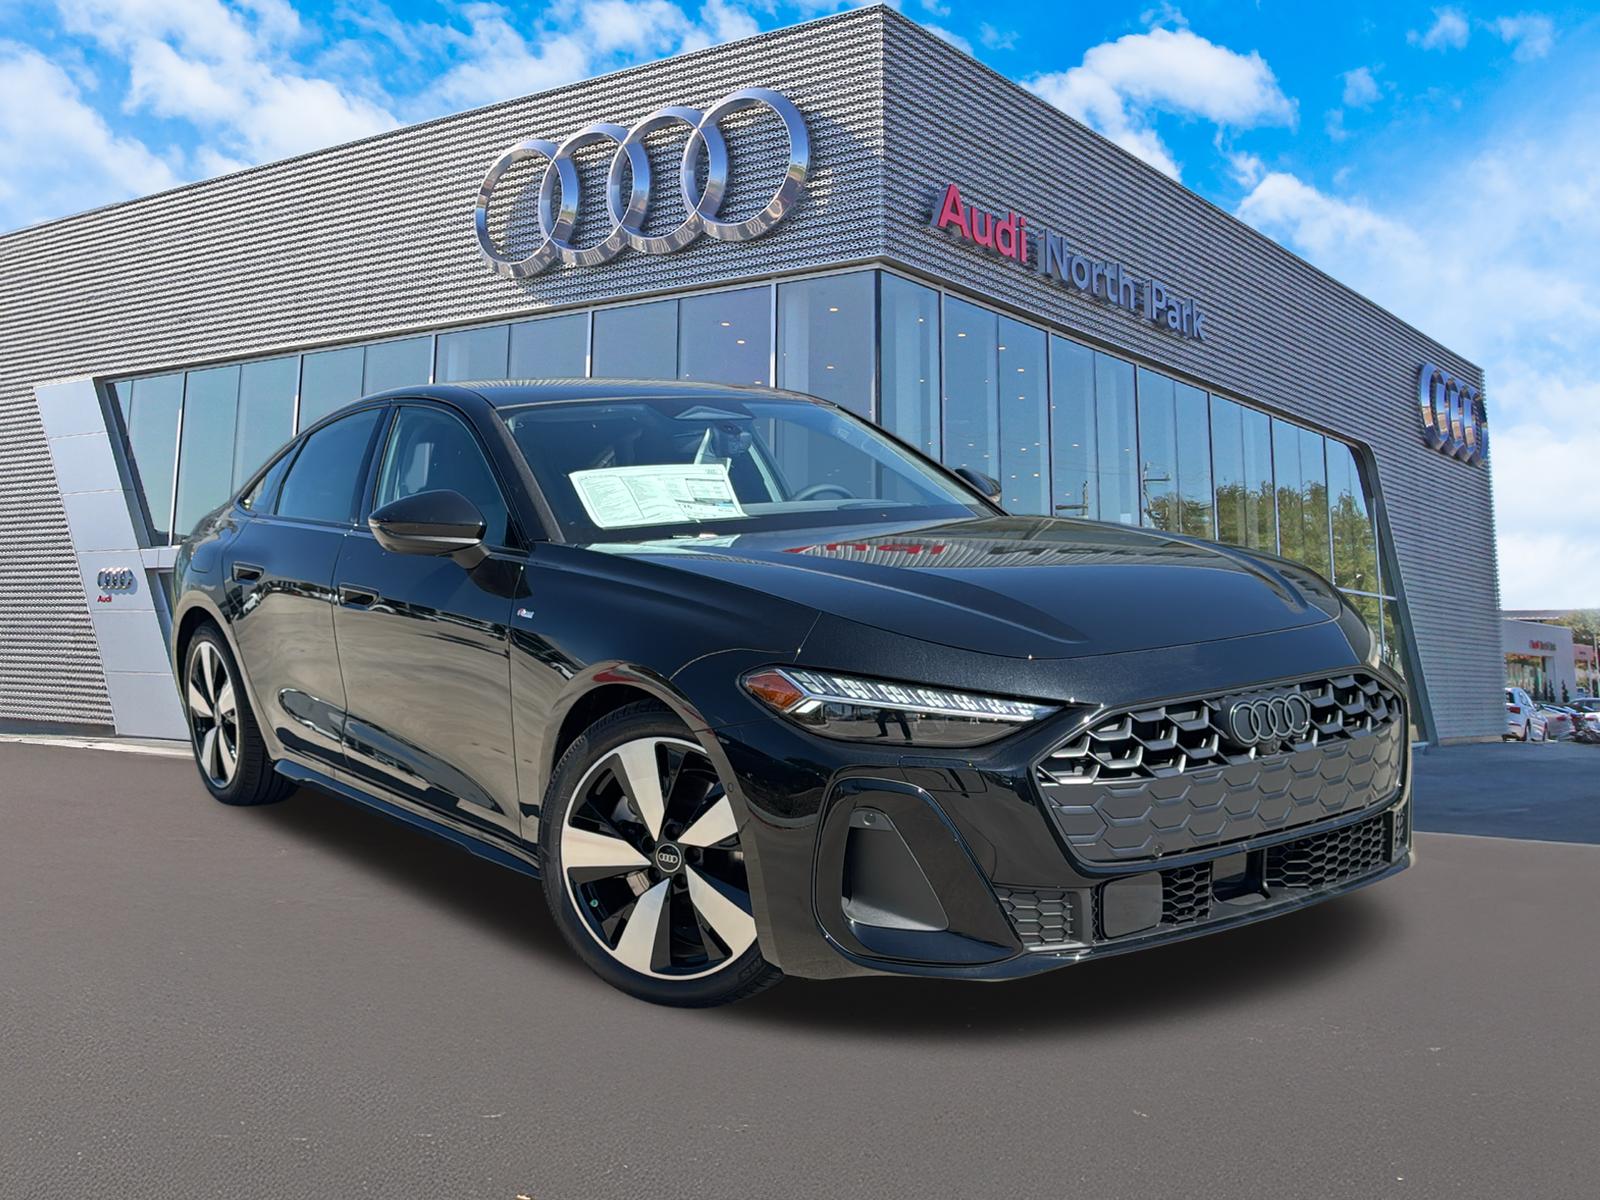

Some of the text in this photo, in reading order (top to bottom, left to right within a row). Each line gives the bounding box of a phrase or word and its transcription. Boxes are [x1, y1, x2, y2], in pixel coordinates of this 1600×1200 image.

[935, 183, 1206, 341] Audi North Park
